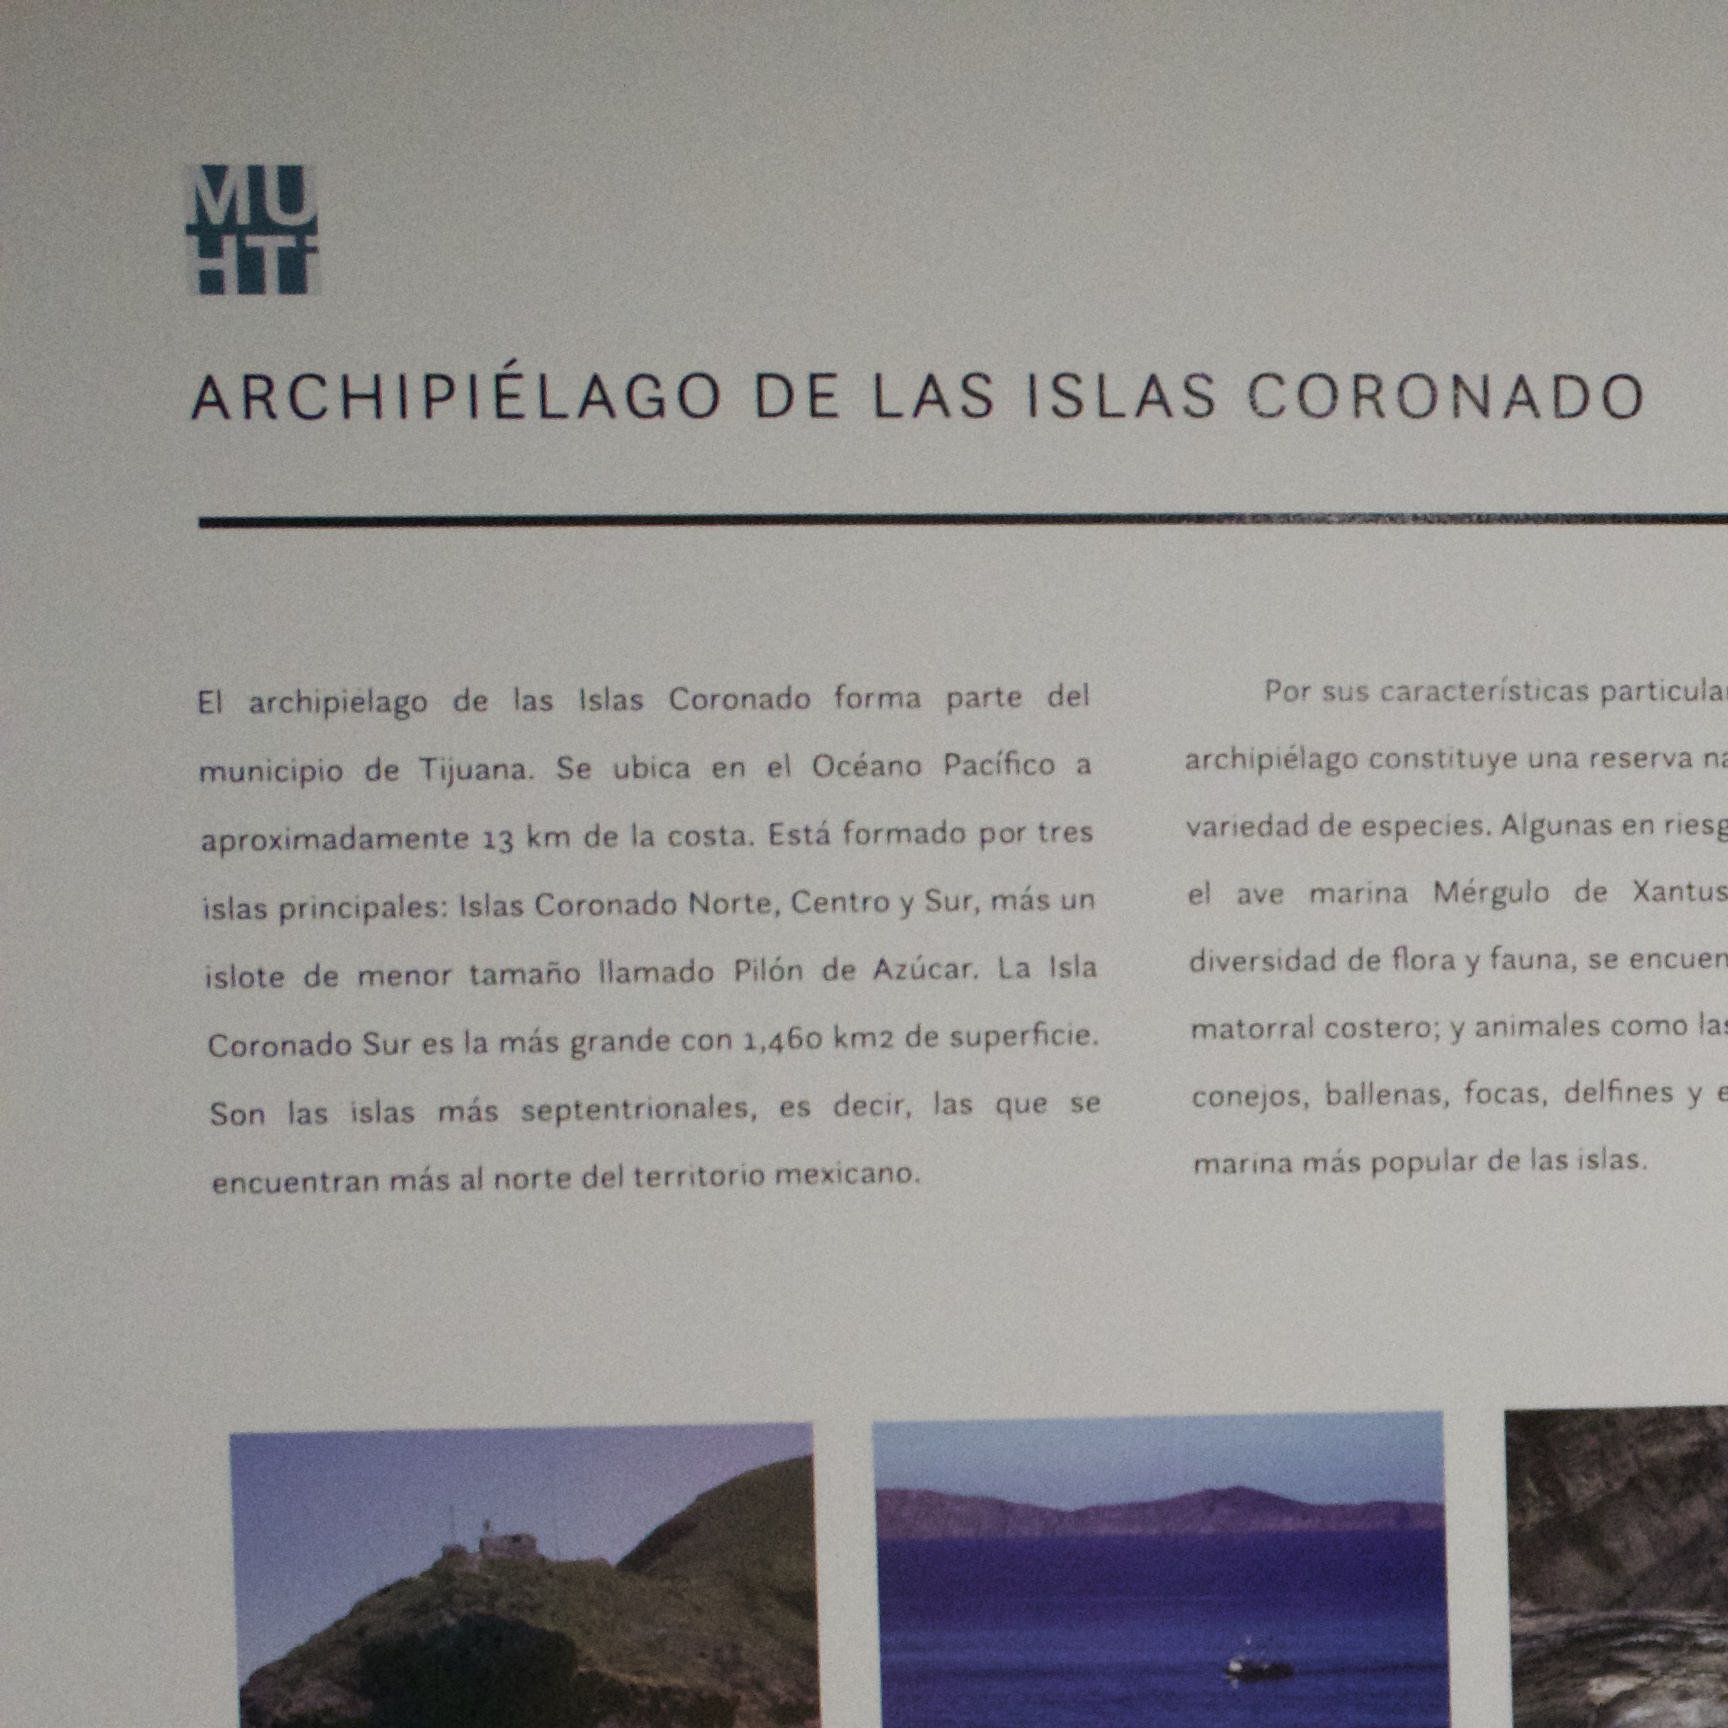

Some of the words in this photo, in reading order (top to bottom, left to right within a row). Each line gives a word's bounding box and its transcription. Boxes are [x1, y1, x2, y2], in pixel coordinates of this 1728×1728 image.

[189, 356, 722, 422] ARCHIPIÉLAGO
[754, 371, 840, 420] DE
[873, 370, 994, 420] LAS
[1027, 370, 1216, 420] ISLAS
[1246, 370, 1644, 421] CORONADO
[1265, 677, 1312, 704] Por
[1322, 684, 1370, 703] sus
[1379, 675, 1590, 703] características
[198, 757, 344, 790] municipio
[363, 755, 400, 783] de
[417, 755, 535, 790] Tijuana.
[556, 754, 593, 781] Se
[612, 753, 691, 781] ubica
[711, 760, 746, 780] en
[766, 751, 792, 780] el
[811, 750, 923, 779] Océano
[943, 748, 1056, 778] Pacífico
[1075, 756, 1093, 776] a
[1184, 743, 1359, 778] archipiélago
[1368, 748, 1518, 777] constituye
[1527, 750, 1580, 770] una
[1589, 750, 1694, 770] reserva
[200, 823, 470, 860] aproximadamente
[483, 829, 515, 855] 13
[526, 822, 571, 849] km
[582, 822, 620, 850] de
[630, 821, 656, 849] la
[667, 824, 755, 848] costa.
[768, 819, 832, 847] Está
[842, 818, 967, 847] formado
[978, 825, 1027, 852] por
[1037, 821, 1094, 845] tres
[1185, 811, 1310, 839] variedad
[1317, 811, 1353, 838] de
[1360, 818, 1493, 844] especies.
[1500, 811, 1614, 845] Algunas
[1620, 817, 1655, 837] en
[205, 962, 286, 990] islote
[302, 961, 340, 989] de
[357, 967, 453, 989] menor
[468, 960, 582, 987] tamaño
[598, 957, 715, 985] llamado
[734, 955, 804, 983] Pilón
[820, 955, 857, 983] de
[872, 953, 979, 982] Azúcar.
[997, 955, 1032, 981] La
[1049, 952, 1098, 980] Isla
[1188, 946, 1337, 974] diversidad
[1346, 946, 1382, 973] de
[1391, 944, 1457, 972] flora
[1464, 953, 1481, 979] y
[1489, 944, 1578, 975] fauna,
[1588, 951, 1619, 971] se
[207, 1029, 353, 1059] Coronado
[362, 1030, 413, 1057] Sur
[421, 1036, 455, 1057] es
[463, 1028, 489, 1056] la
[498, 1026, 560, 1055] más
[569, 1025, 672, 1062] grande
[680, 1032, 733, 1053] con
[743, 1024, 824, 1055] 1,460
[833, 1023, 894, 1050] km2
[904, 1022, 940, 1049] de
[949, 1019, 1099, 1055] superficie.
[1190, 1013, 1315, 1041] matorral
[1323, 1017, 1441, 1043] costero;
[1449, 1020, 1466, 1046] y
[1474, 1011, 1602, 1039] animales
[1610, 1017, 1689, 1038] como
[211, 1170, 380, 1196] encuentran
[389, 1164, 451, 1193] más
[459, 1164, 484, 1193] al
[493, 1167, 573, 1192] norte
[580, 1162, 625, 1191] del
[632, 1165, 766, 1189] territorio
[774, 1165, 921, 1186] mexicano.
